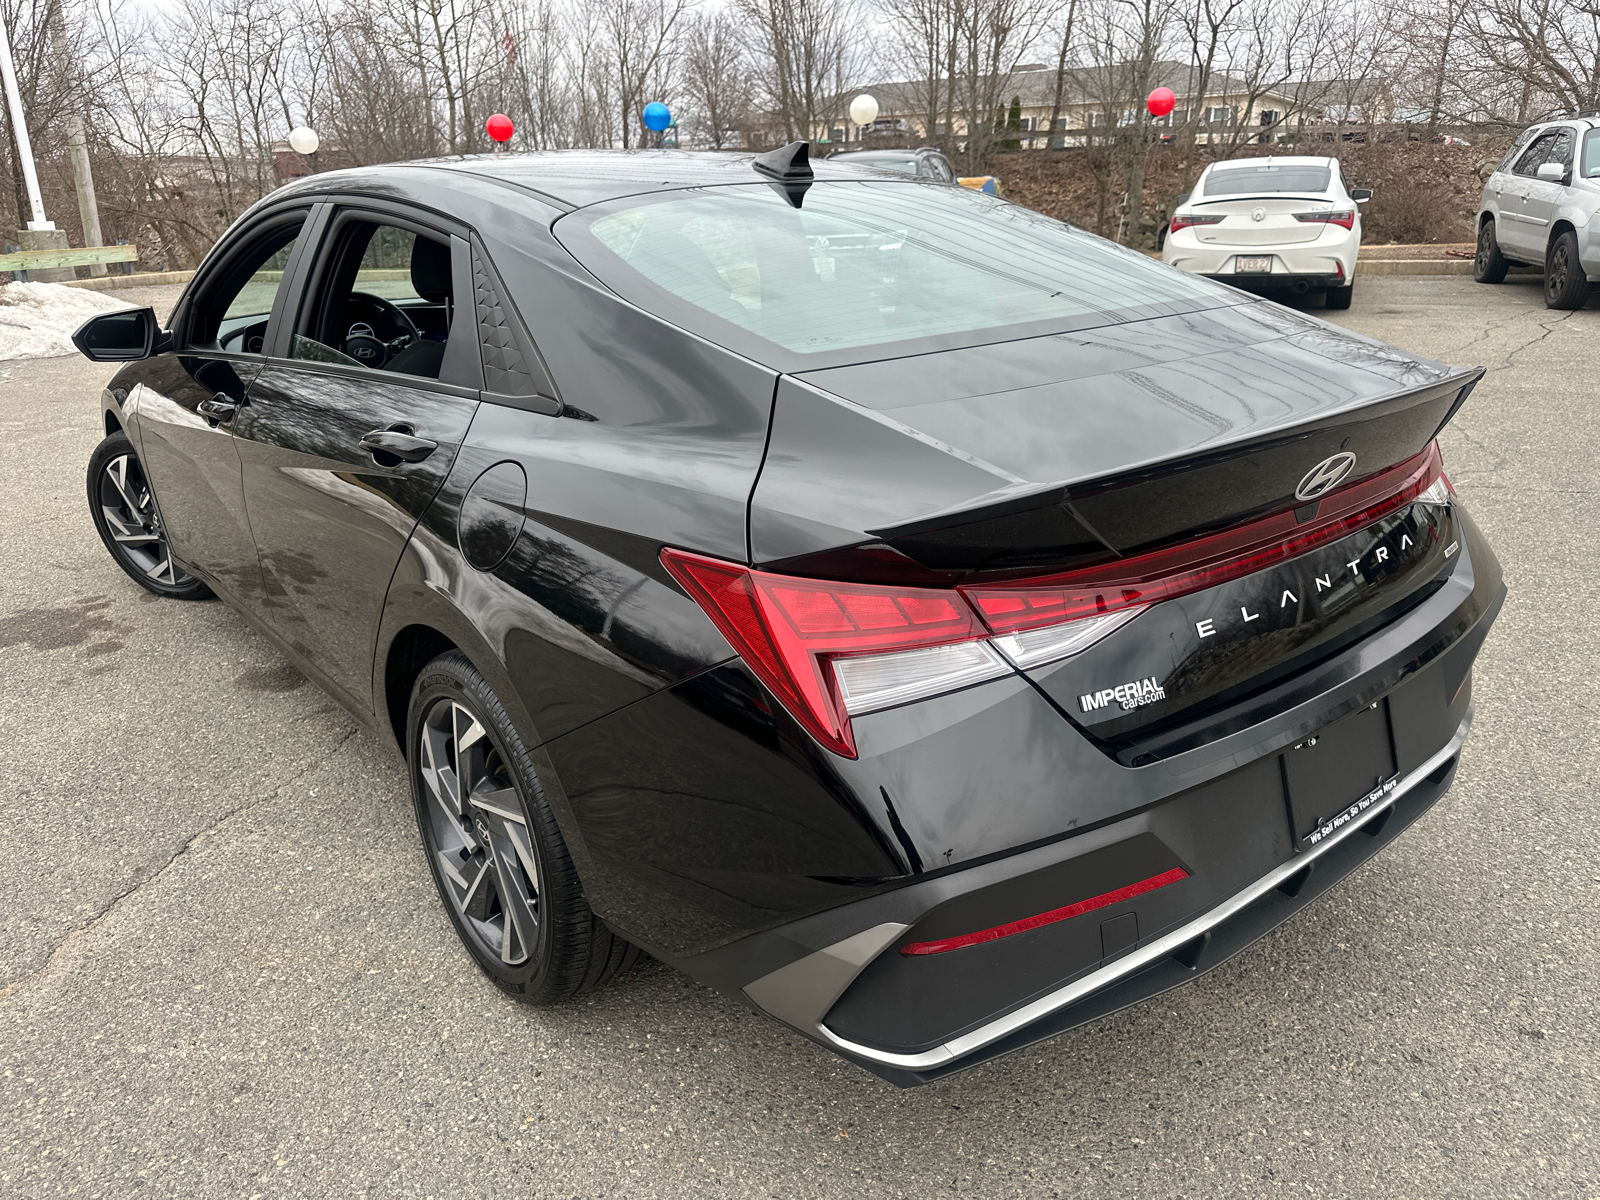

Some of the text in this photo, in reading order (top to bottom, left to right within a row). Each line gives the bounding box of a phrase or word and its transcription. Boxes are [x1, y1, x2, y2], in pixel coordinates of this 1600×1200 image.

[1196, 534, 1414, 638] ELANTRA
[1080, 676, 1164, 712] IMPERIAL
[1122, 690, 1166, 710] cars.com
[1310, 779, 1397, 844] We Sell More, So You Save More
